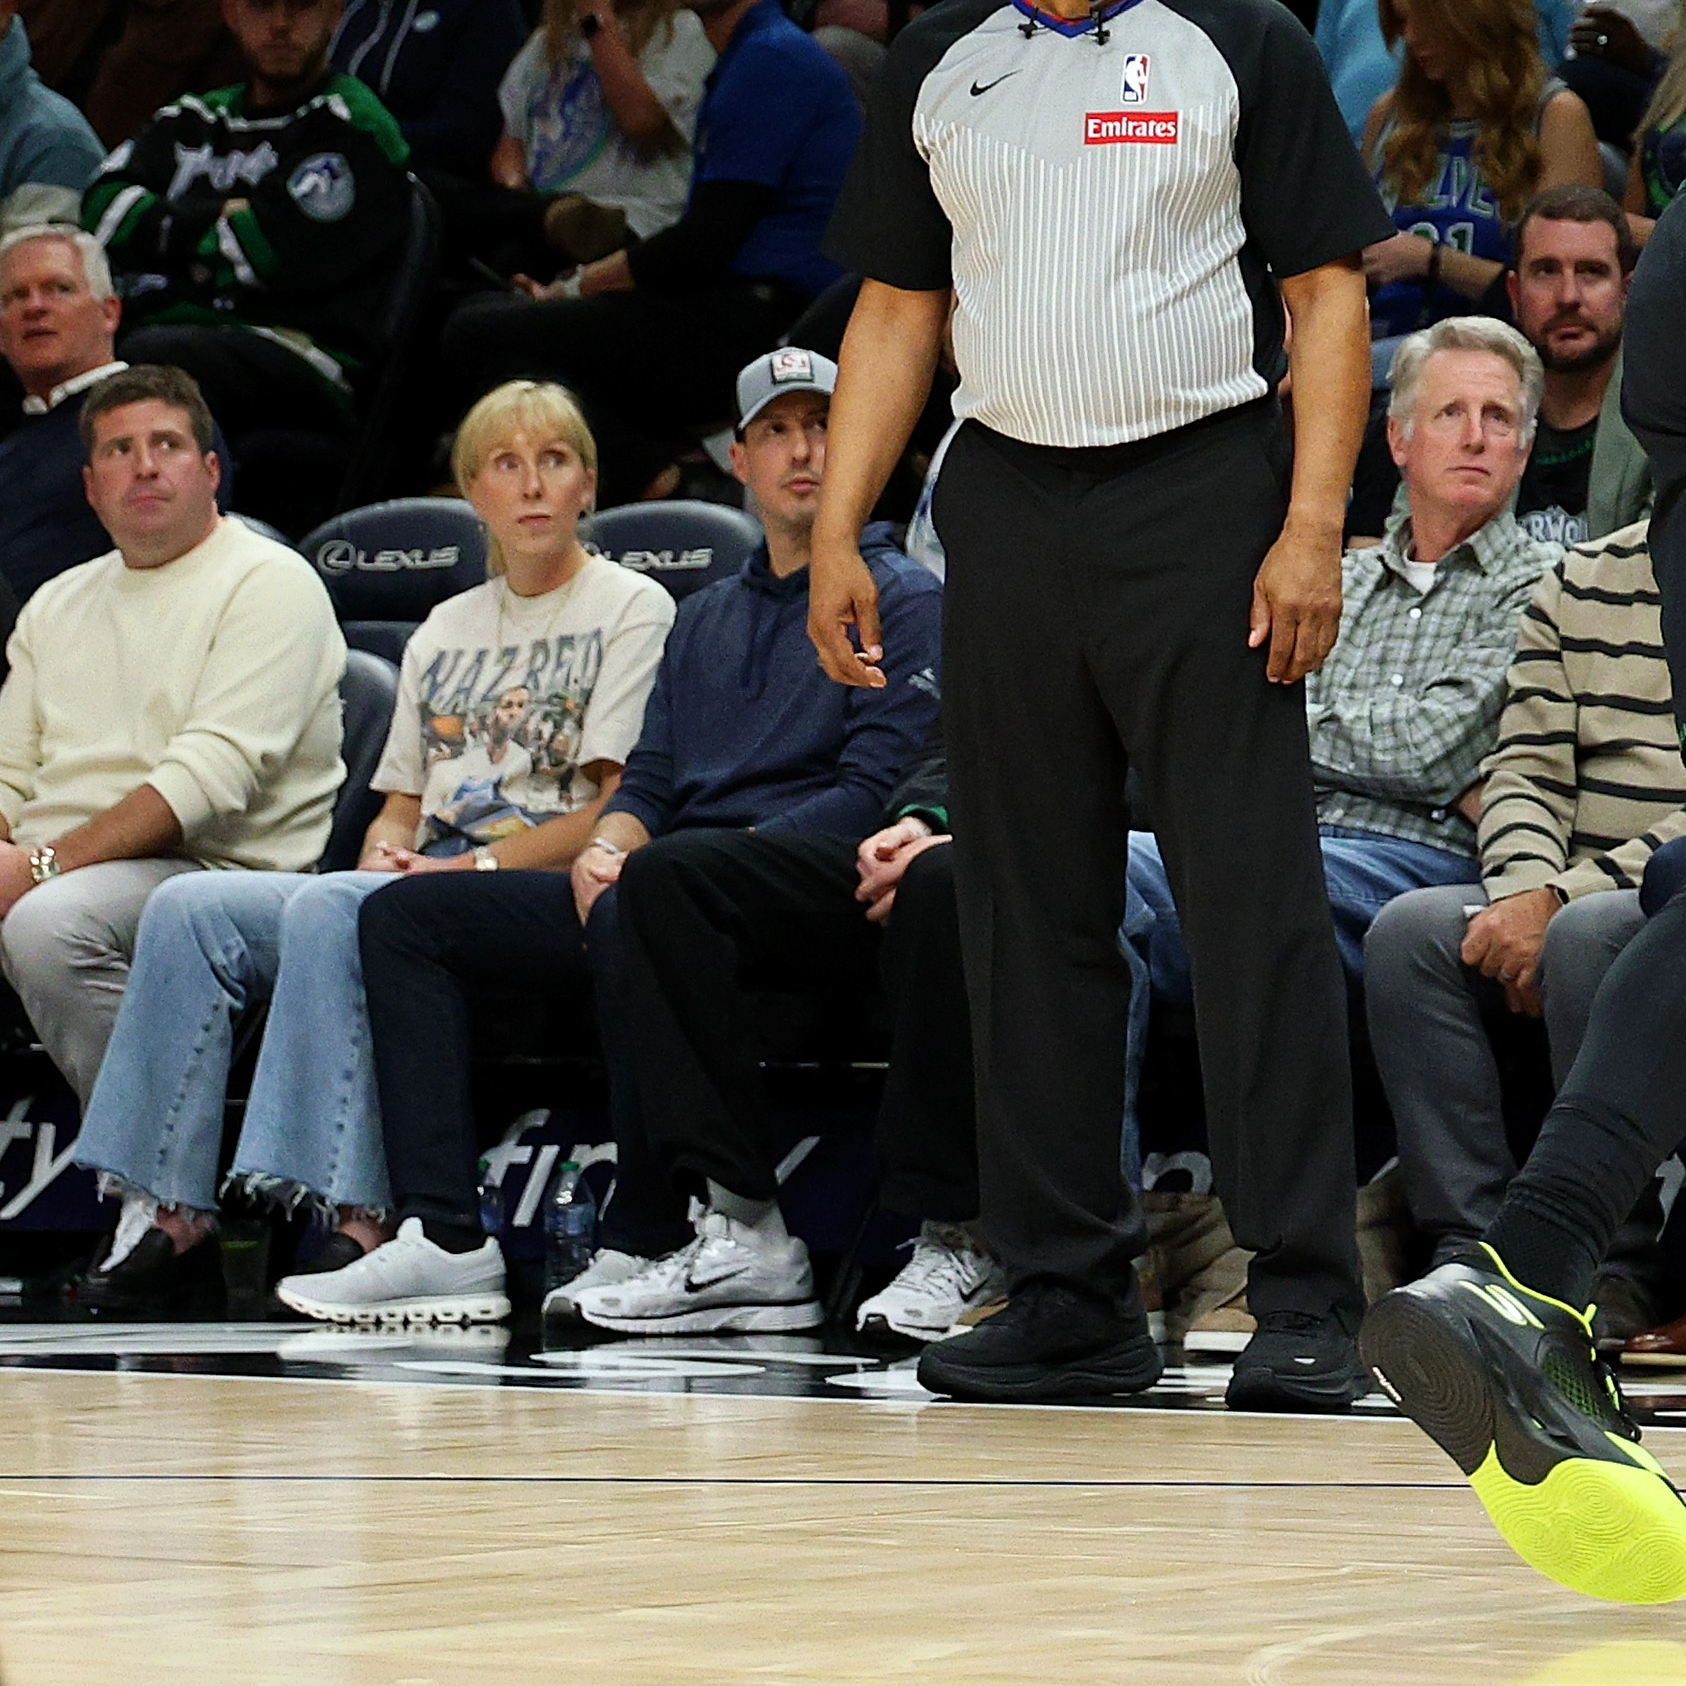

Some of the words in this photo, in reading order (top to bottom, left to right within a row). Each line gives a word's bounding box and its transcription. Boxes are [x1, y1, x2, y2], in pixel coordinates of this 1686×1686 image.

[1087, 117, 1176, 139] Emirates
[356, 545, 461, 570] LEXUS
[602, 547, 714, 571] EXUS
